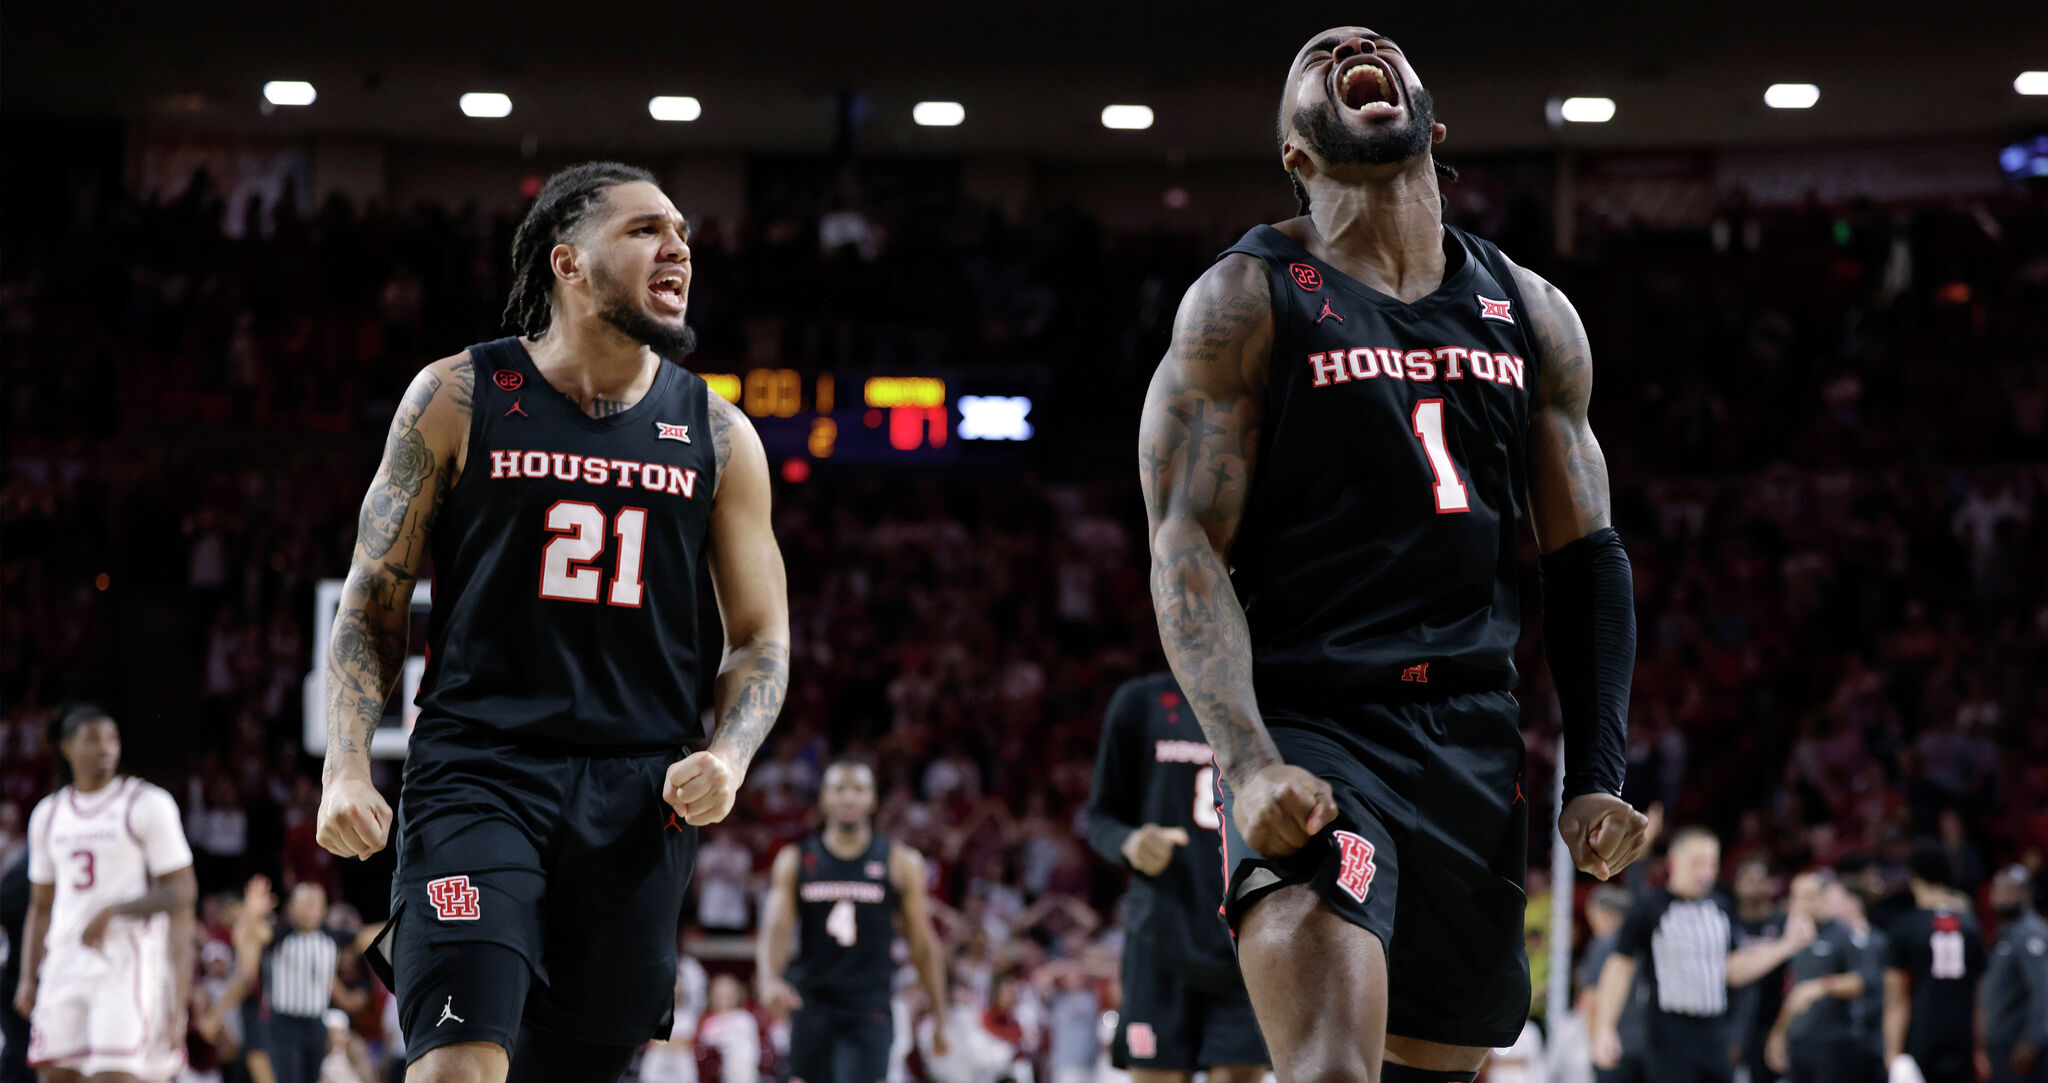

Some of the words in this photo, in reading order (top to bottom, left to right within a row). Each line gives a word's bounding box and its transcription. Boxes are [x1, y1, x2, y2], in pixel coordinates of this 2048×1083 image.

[1295, 267, 1319, 285] 32
[1480, 298, 1511, 320] XII
[1308, 346, 1525, 390] HOUSTON
[659, 424, 688, 441] XII
[490, 450, 697, 499] HOUSTON
[1411, 398, 1471, 514] 1
[539, 499, 648, 609] 21
[71, 849, 95, 891] 3
[427, 875, 480, 920] UH
[826, 899, 858, 948] 4
